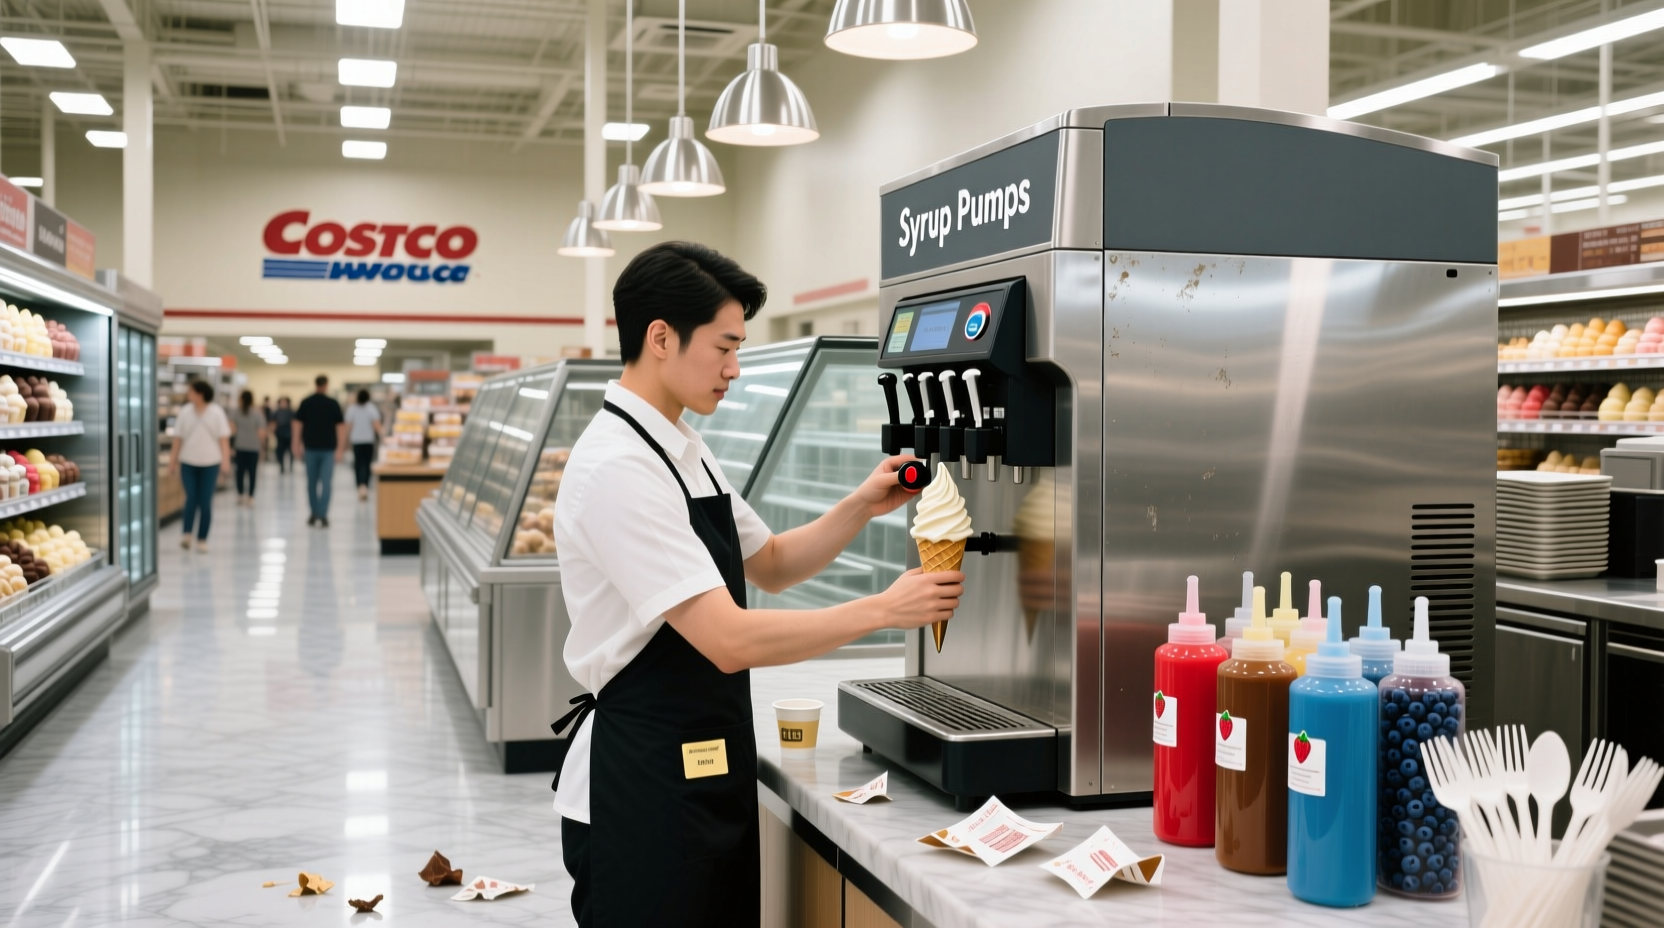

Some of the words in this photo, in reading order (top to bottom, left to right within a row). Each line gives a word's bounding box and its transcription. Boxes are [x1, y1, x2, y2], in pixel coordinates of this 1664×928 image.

[262, 209, 479, 260] COSTCO
[899, 205, 952, 256] Syrup
[957, 179, 1031, 231] Pumps
